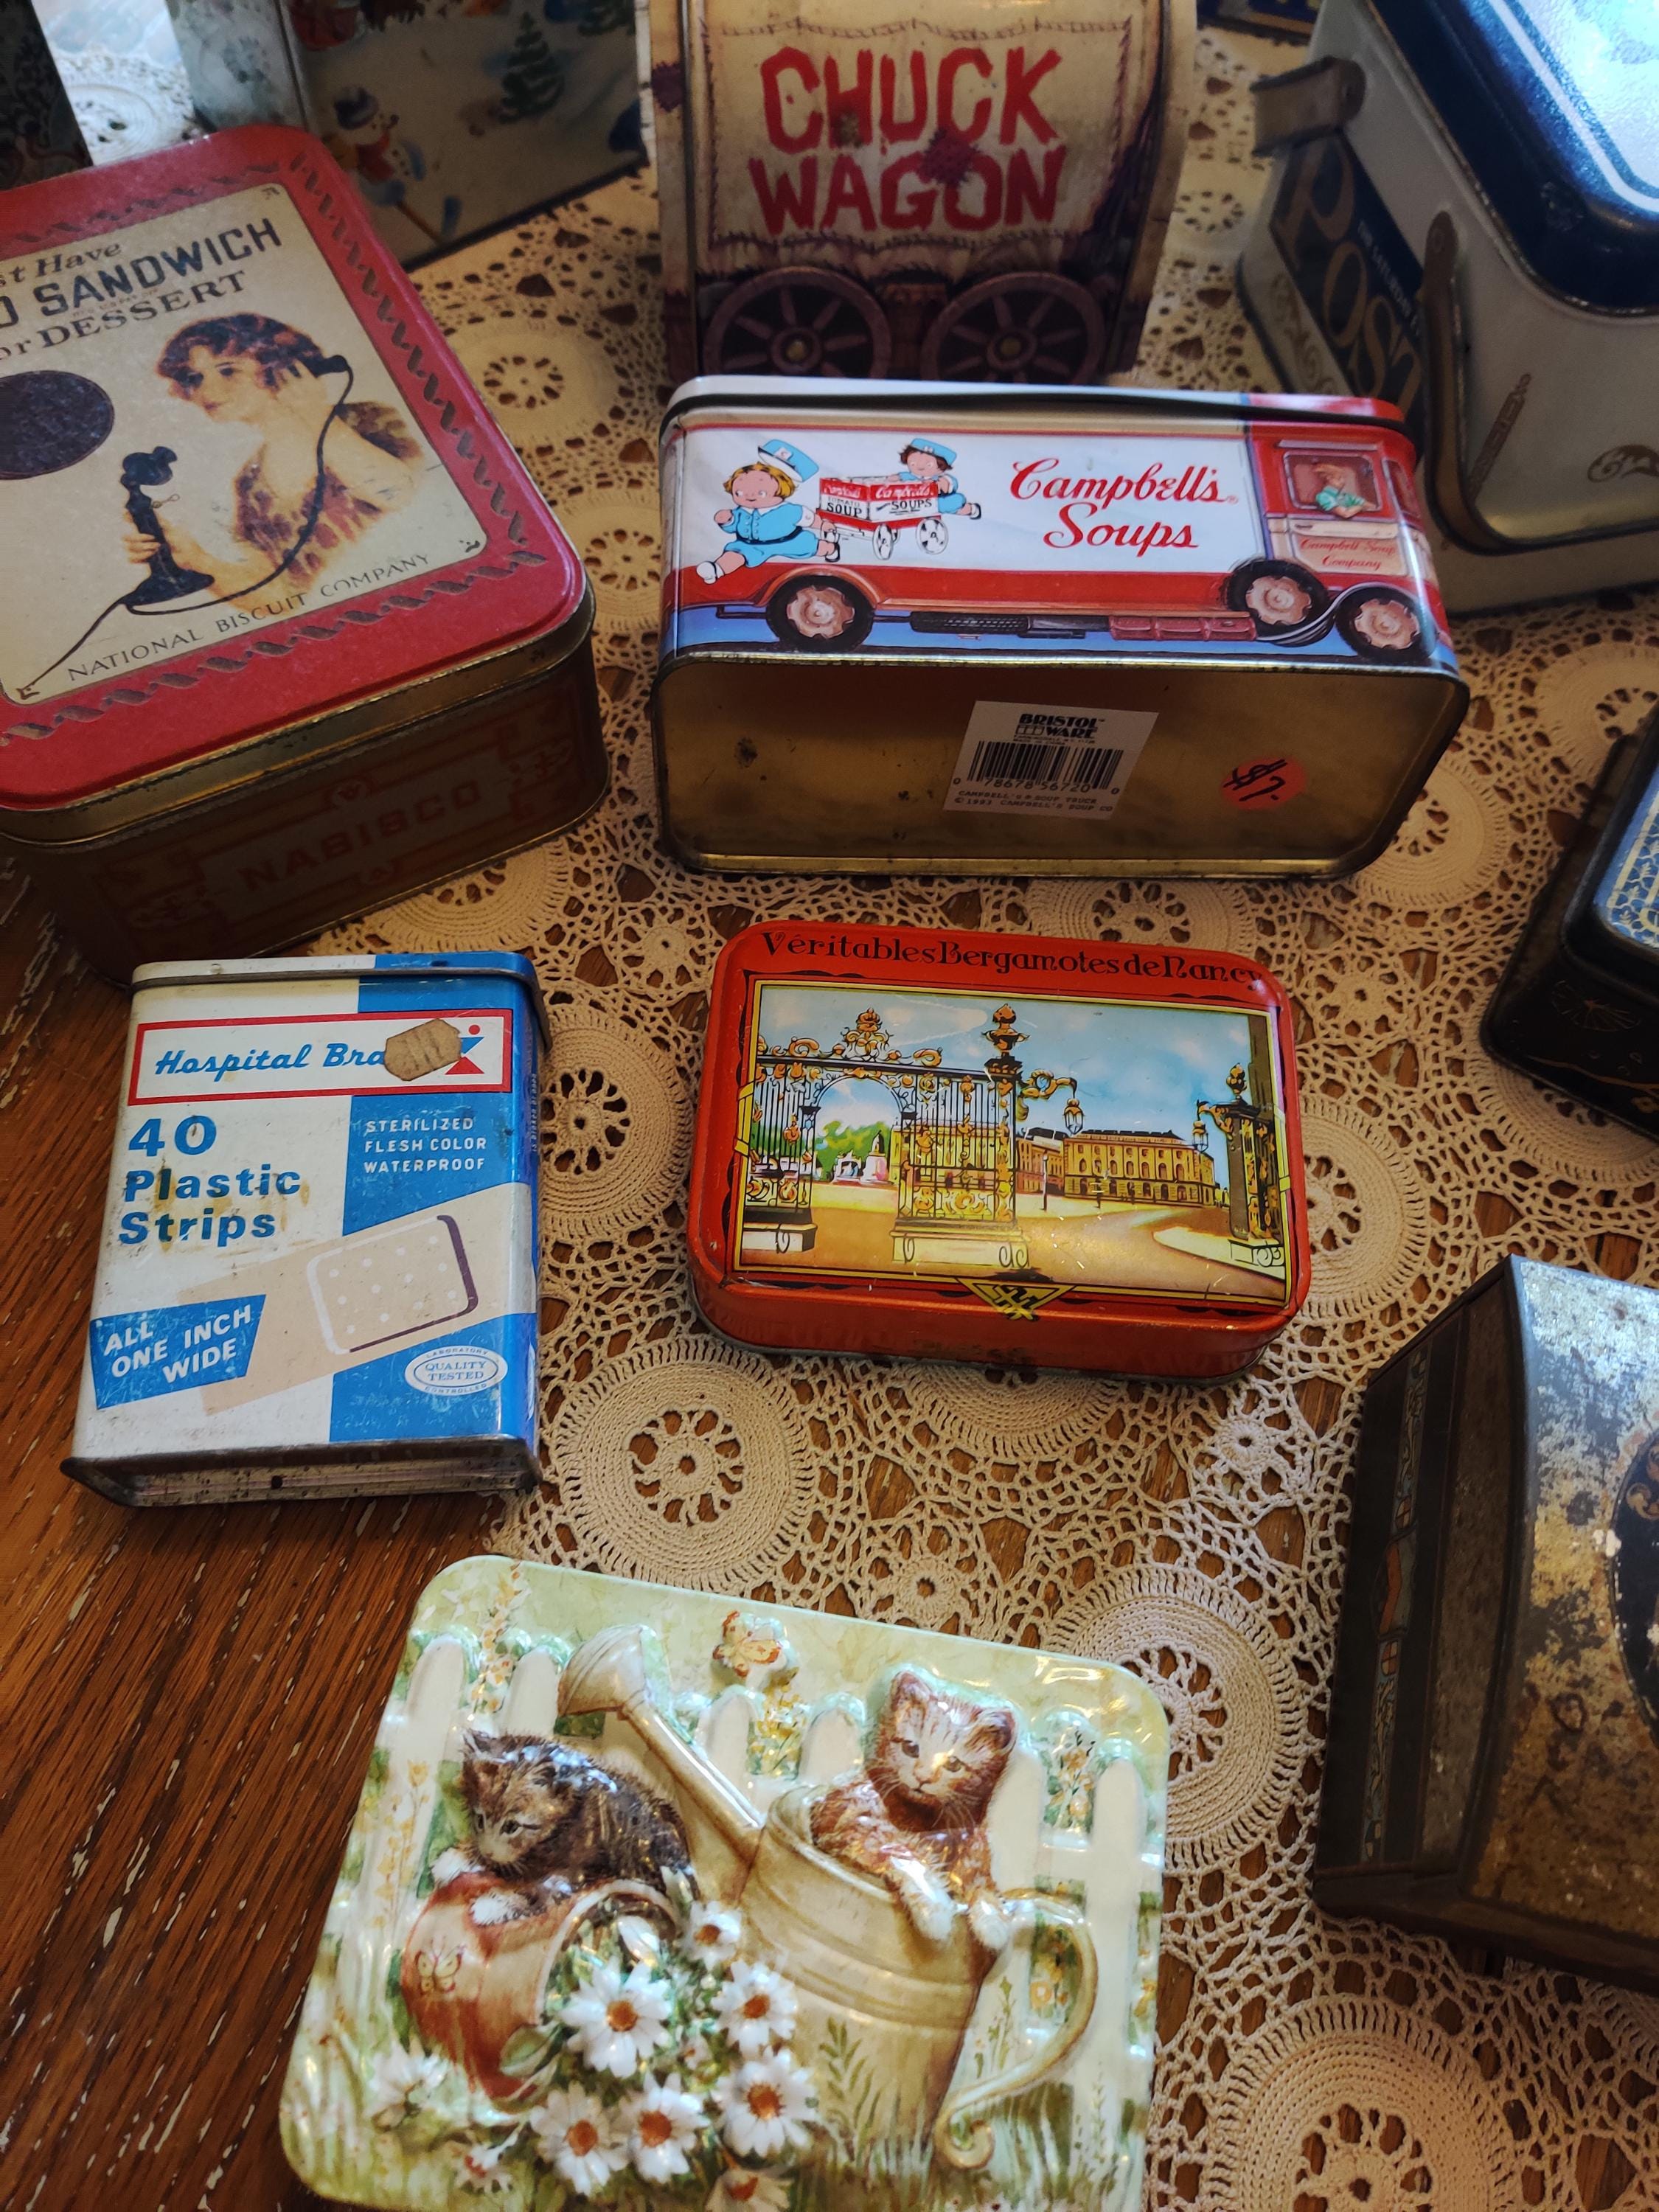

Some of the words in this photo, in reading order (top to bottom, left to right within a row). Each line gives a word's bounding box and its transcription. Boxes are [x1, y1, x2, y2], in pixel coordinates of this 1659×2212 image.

[759, 45, 1063, 153] CHUCK
[748, 145, 1066, 235] WAGON
[33, 218, 282, 317] SANDWICH
[36, 243, 122, 277] Have
[36, 270, 246, 349] DESSERT
[1009, 456, 1231, 510] Campbell's
[826, 502, 863, 518] SOUP
[891, 498, 933, 510] SOUPS
[1043, 501, 1200, 557] Soups
[1321, 555, 1383, 571] Company
[67, 628, 202, 681] NATIONAL
[214, 592, 308, 634] BISCUIT
[319, 552, 433, 597] COMPANY
[1019, 713, 1099, 728] BRISTOL
[1045, 726, 1099, 739] WARE
[239, 779, 481, 892] NABISCO
[762, 930, 936, 967] Véritables
[937, 941, 1119, 975] Bergamotes
[1120, 953, 1160, 978] de
[154, 1043, 314, 1082] Hospital
[128, 1113, 218, 1158] 40
[364, 1116, 475, 1134] STERILIZED
[364, 1138, 422, 1154] FLESH
[429, 1136, 488, 1152] COLOR
[123, 1163, 302, 1203] Plastic
[363, 1157, 486, 1175] WATERPROOF
[118, 1206, 276, 1248] Strips
[102, 1321, 155, 1356] ALL
[111, 1342, 168, 1379] ONE
[184, 1304, 251, 1349] INCH
[426, 1347, 489, 1358] LABORATORY
[161, 1338, 237, 1384] WIDE
[425, 1361, 487, 1371] QUALITY
[428, 1371, 484, 1381] TESTED
[424, 1383, 487, 1394] CONTROLLED
